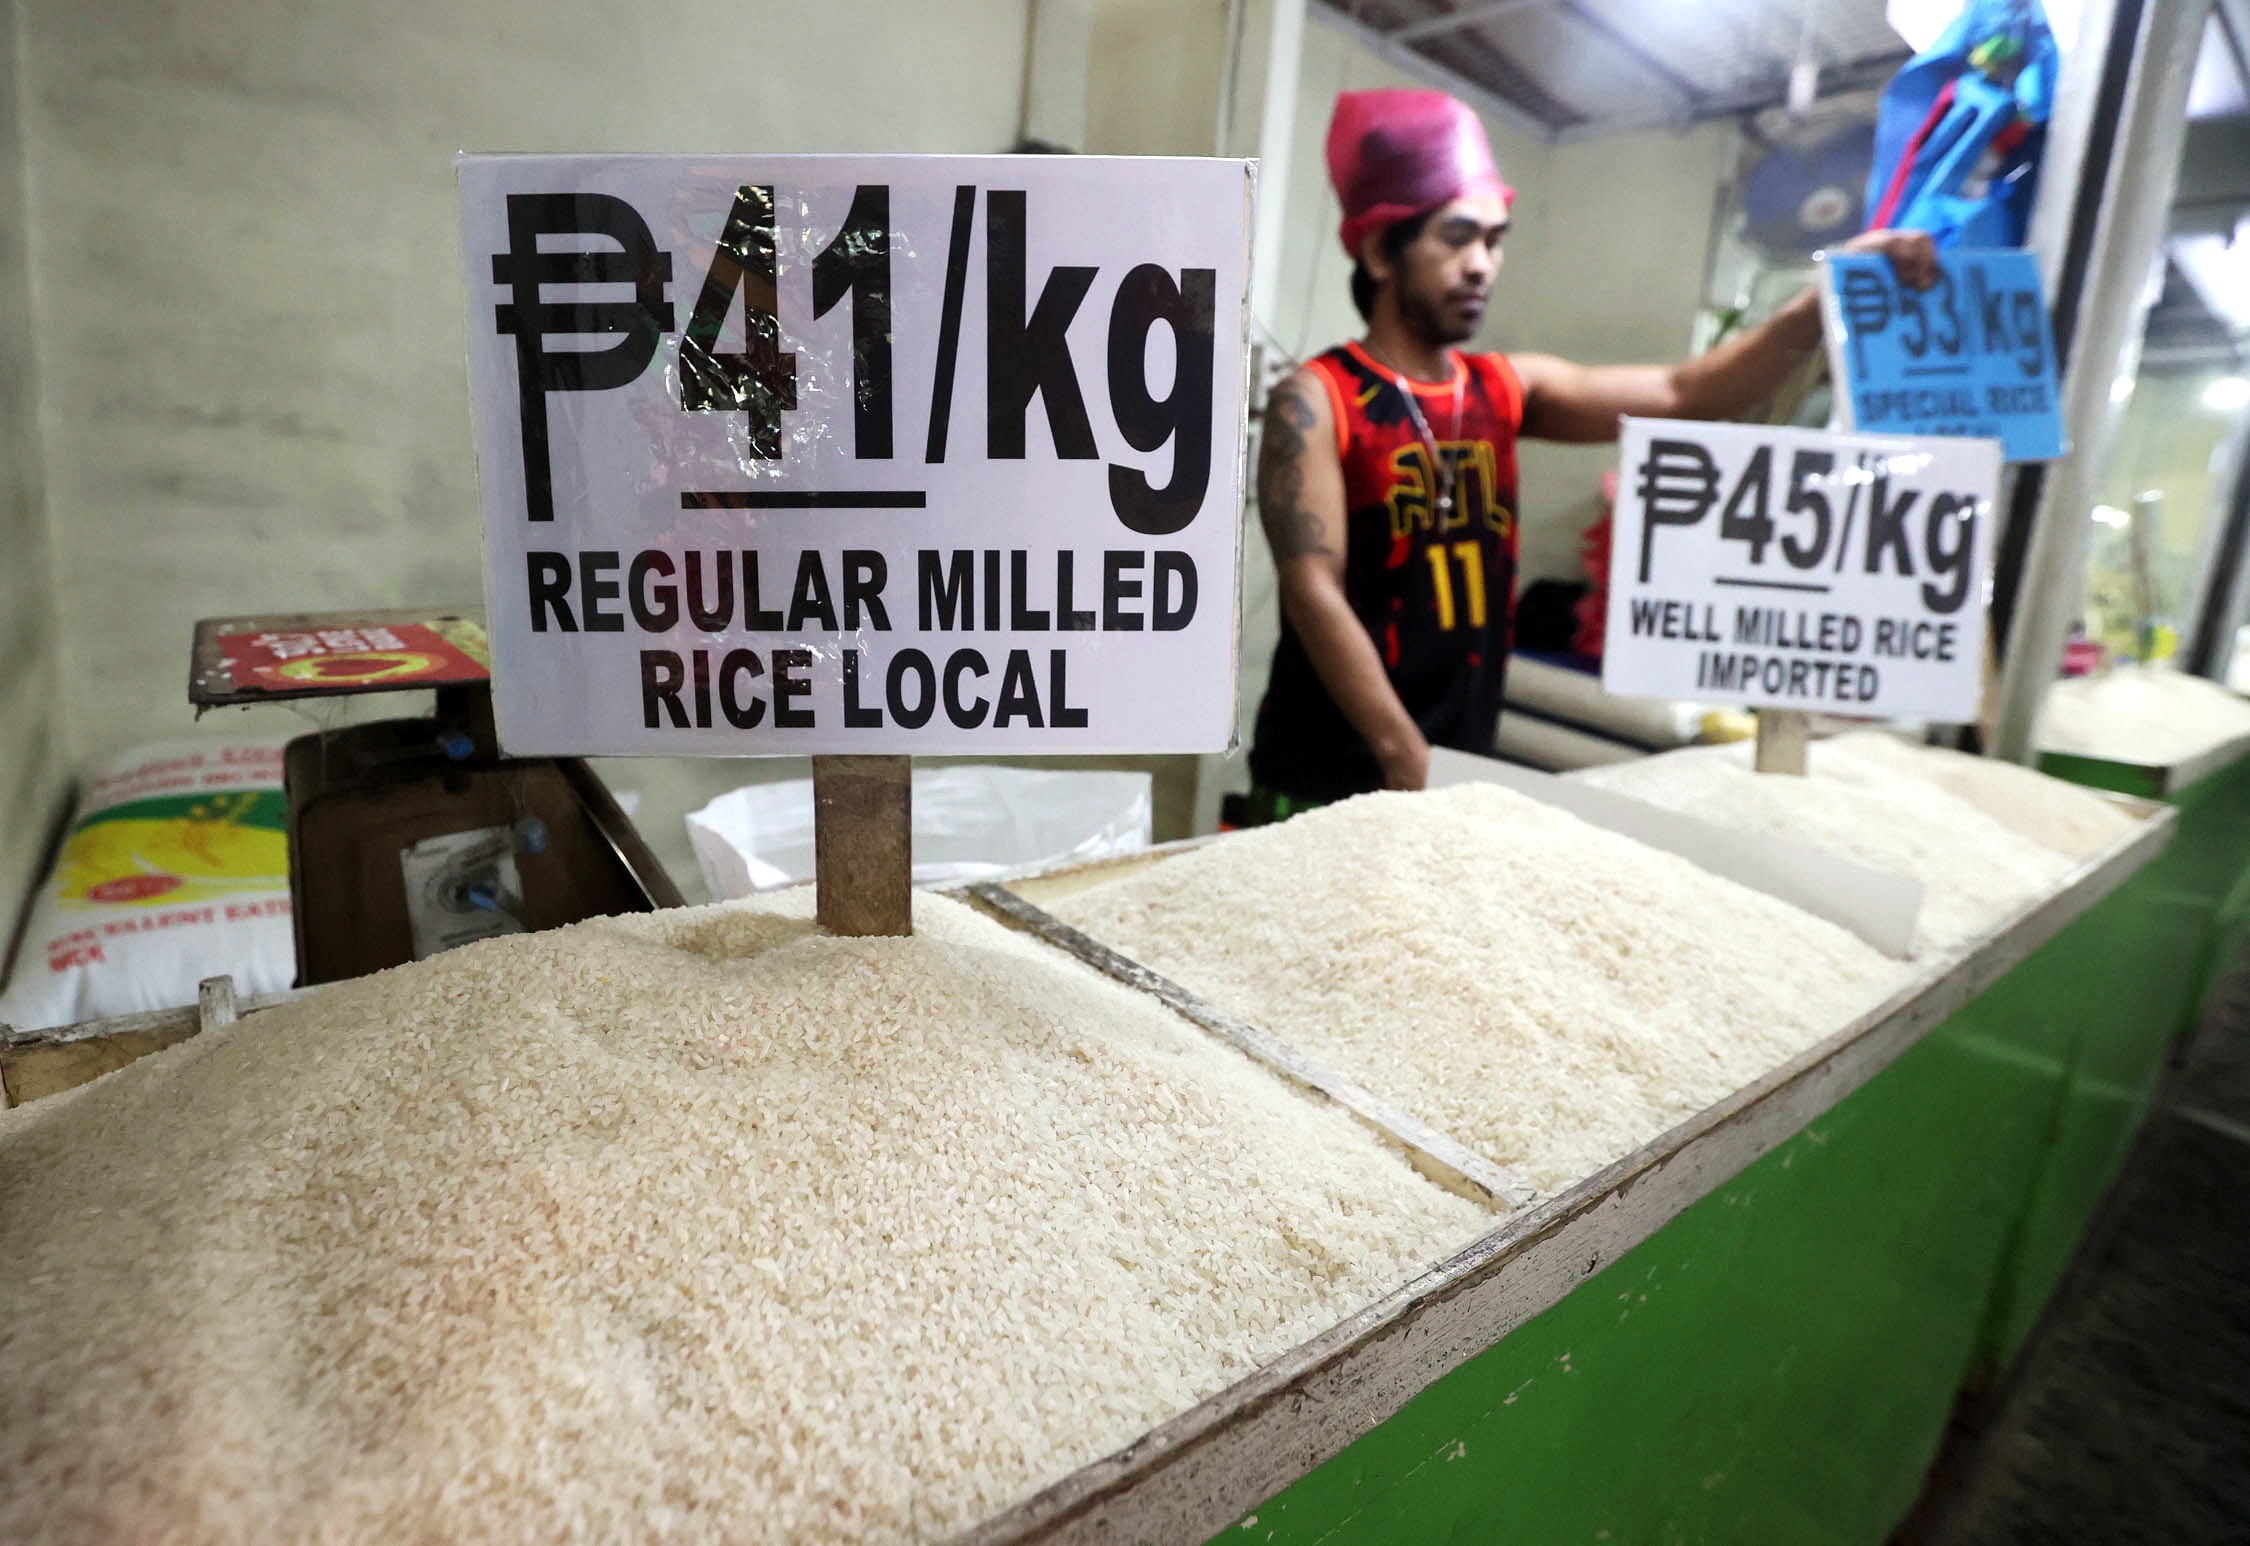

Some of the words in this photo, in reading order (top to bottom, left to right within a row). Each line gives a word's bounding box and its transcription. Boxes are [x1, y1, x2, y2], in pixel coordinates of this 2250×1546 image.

[492, 185, 1217, 534] ₱41/kg
[1985, 384, 2051, 415] RICE
[1637, 438, 1977, 614] ₱45/kg
[526, 550, 889, 634] REGULAR
[918, 550, 1199, 633] MILLED
[1426, 540, 1486, 631] 11
[1630, 598, 1721, 643] WELL
[1734, 606, 1863, 653] MILLED
[1874, 618, 1959, 662] RICE
[640, 648, 815, 730] RICE
[843, 647, 1089, 731] LOCAL
[1696, 652, 1879, 703] IMPORTED
